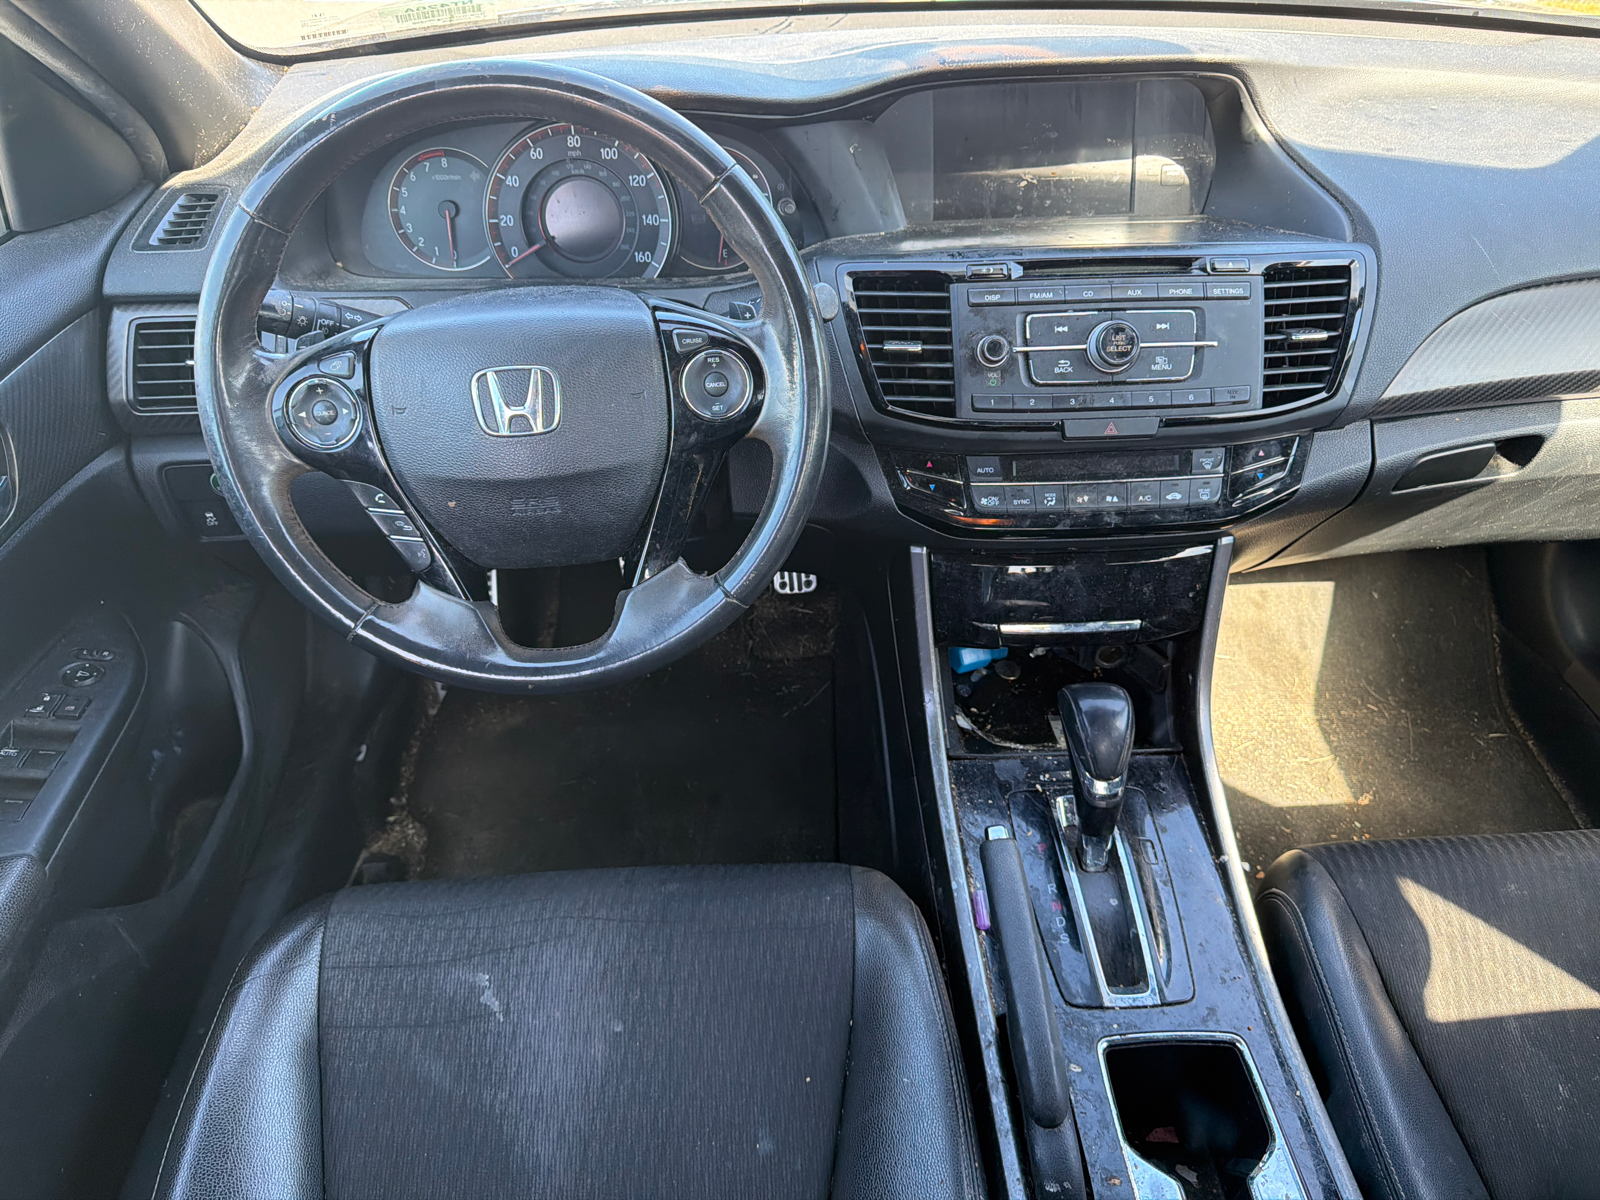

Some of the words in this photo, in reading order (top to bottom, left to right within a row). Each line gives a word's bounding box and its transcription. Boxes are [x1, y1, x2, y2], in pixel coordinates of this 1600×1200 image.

[567, 135, 581, 147] 80
[530, 147, 543, 160] 60
[600, 147, 618, 160] 100
[424, 162, 430, 172] 7
[441, 157, 448, 168] 8
[409, 171, 416, 182] 6
[505, 175, 520, 187] 40
[628, 174, 646, 187] 120
[401, 187, 408, 197] 5
[400, 205, 406, 215] 4
[500, 215, 514, 227] 20
[642, 214, 660, 226] 140
[405, 223, 413, 233] 3
[418, 237, 425, 247] 2
[435, 246, 439, 256] 1
[511, 246, 518, 257] 0
[723, 249, 728, 258] E
[634, 251, 652, 263] 160
[1151, 363, 1173, 371] MENU
[1038, 843, 1046, 853] P
[1047, 884, 1057, 894] R
[1052, 902, 1062, 911] N
[1056, 917, 1065, 927] D
[1060, 933, 1069, 943] S
